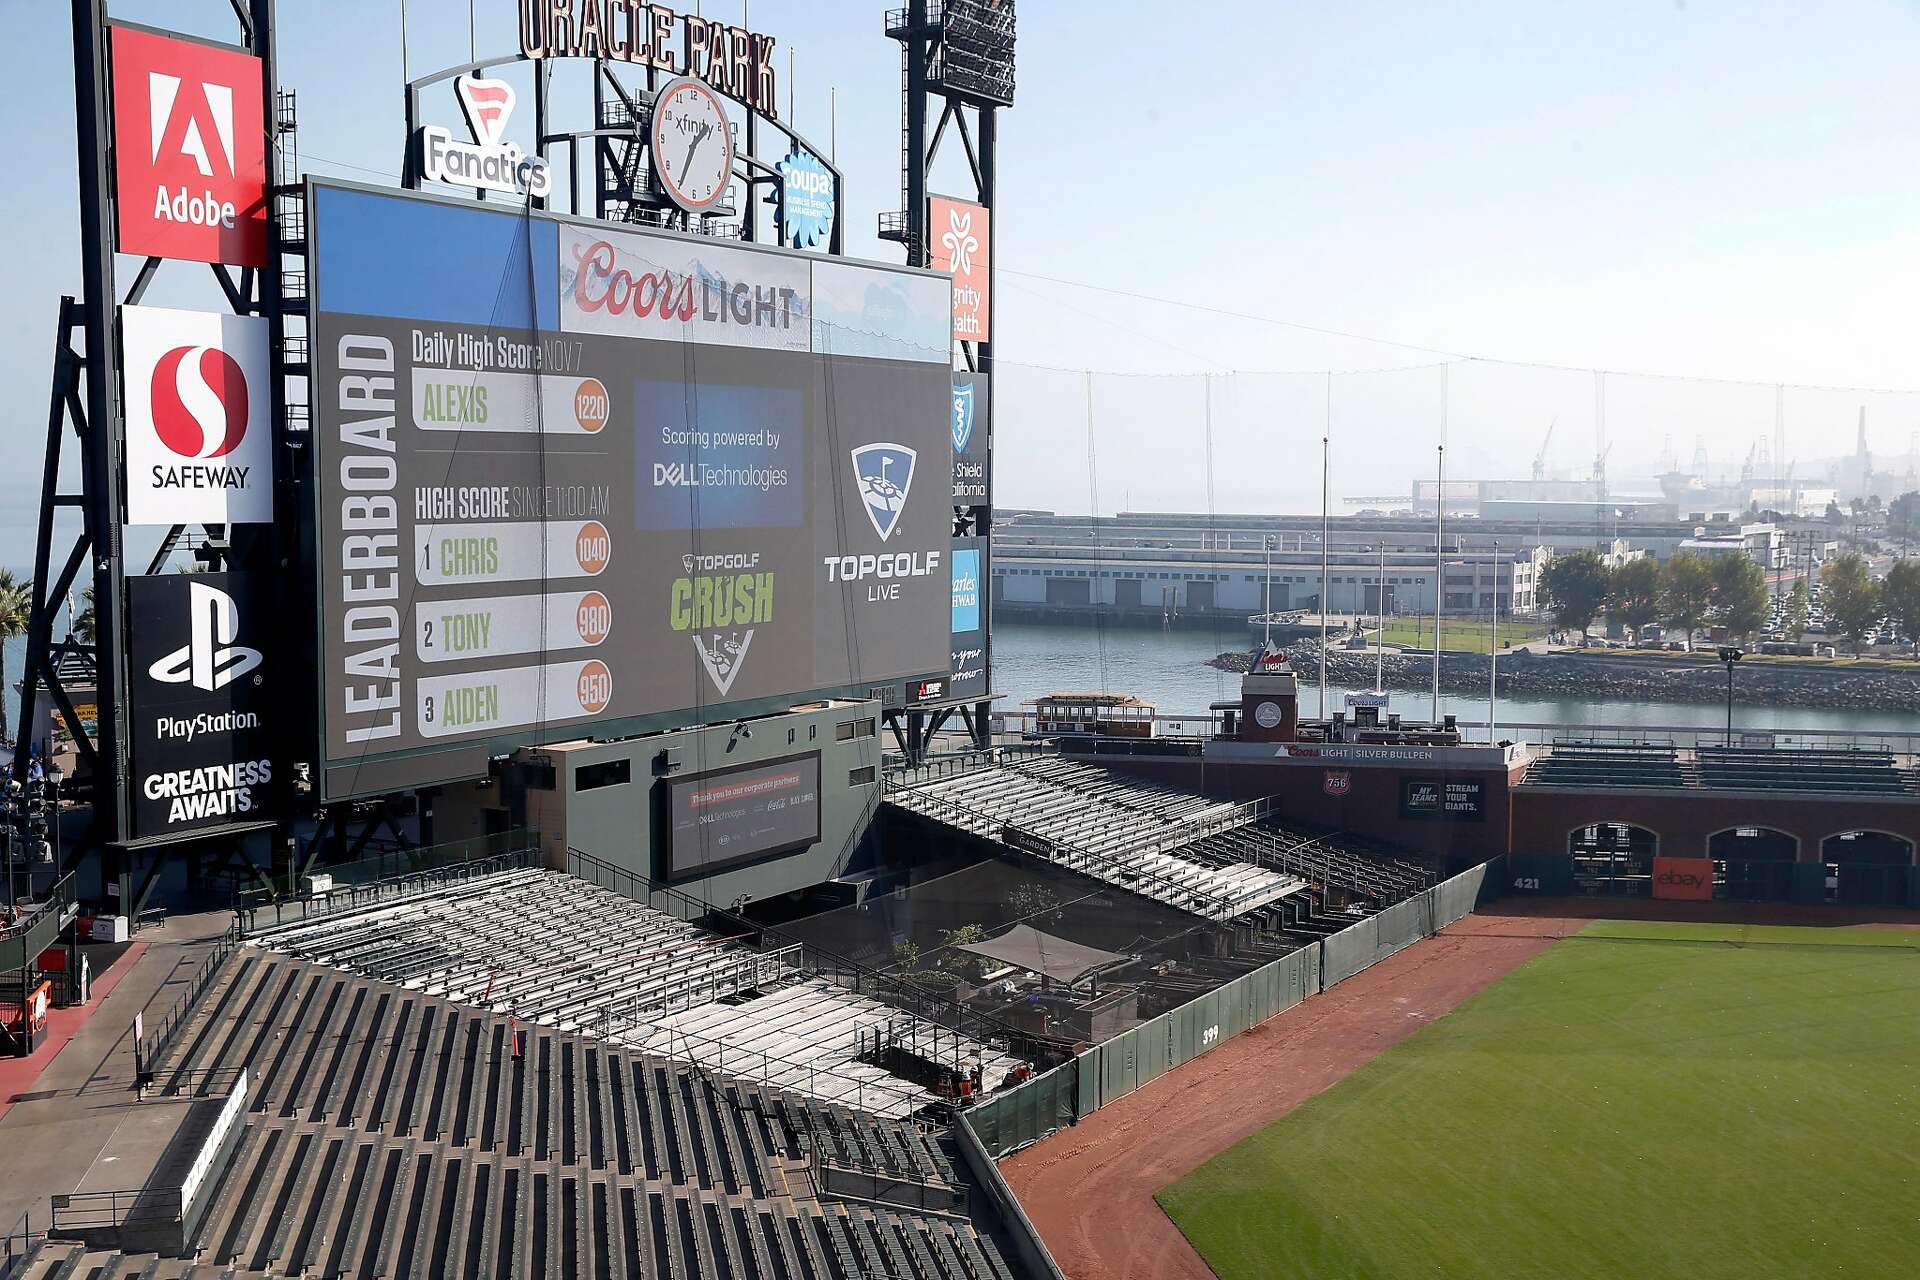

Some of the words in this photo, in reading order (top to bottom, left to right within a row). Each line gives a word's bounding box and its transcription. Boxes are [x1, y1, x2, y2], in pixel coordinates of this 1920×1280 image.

[518, 0, 674, 72] ORACLE
[685, 14, 777, 119] PARK
[675, 93, 682, 104] 11
[690, 90, 698, 100] 12
[665, 110, 672, 120] 10
[429, 134, 546, 188] Fanatics
[783, 167, 829, 199] coupa
[154, 185, 235, 229] Adobe
[572, 241, 698, 322] Coors
[702, 279, 795, 329] LIGHT
[412, 329, 454, 368] Daily
[457, 333, 494, 371] High
[498, 337, 542, 370] Score
[545, 340, 574, 370] NOV
[575, 342, 582, 372] 7
[423, 383, 488, 423] ALEXIS
[577, 395, 605, 420] 1220
[662, 426, 710, 449] Scoring
[713, 429, 763, 449] powered
[767, 429, 780, 450] by
[152, 465, 250, 489] SAFEWAY
[653, 462, 699, 487] DELL
[699, 463, 788, 491] Technologies
[956, 462, 983, 478] Shield
[415, 487, 454, 519] HIGH
[458, 487, 509, 519] SCORE
[512, 487, 552, 518] SINCE
[588, 486, 609, 517] AM
[338, 334, 400, 743] LEADERBOARD
[578, 537, 607, 561] 1040
[424, 544, 430, 570] 1
[440, 537, 498, 576] CHRIS
[696, 553, 760, 571] TOPGOLF
[823, 551, 941, 583] TOPGOLF
[670, 572, 775, 631] CRUSH
[867, 583, 901, 602] LIVE
[424, 621, 433, 647] 2
[441, 612, 492, 652] TONY
[579, 605, 607, 637] 980
[1265, 663, 1283, 671] LIGHT
[579, 674, 608, 704] 950
[425, 697, 434, 722] 3
[442, 685, 498, 728] AIDEN
[157, 711, 257, 742] PlayStation
[1321, 747, 1347, 757] LIGHT
[1355, 750, 1387, 759] SILVER
[1390, 751, 1432, 760] BULLPEN
[144, 759, 272, 800] GREATNESS
[1327, 778, 1346, 788] 756
[1446, 784, 1479, 792] STREAM
[168, 787, 251, 823] AWAITS
[692, 793, 713, 804] Thank
[712, 790, 725, 801] you
[725, 789, 732, 797] to
[732, 786, 743, 795] our
[744, 781, 774, 793] corporate
[1446, 793, 1467, 801] YOUR
[1445, 802, 1477, 811] GIANTS.
[1020, 837, 1050, 852] GARDEN
[1514, 878, 1539, 889] 421
[1658, 869, 1705, 889] ebay
[1203, 1024, 1219, 1045] 399
